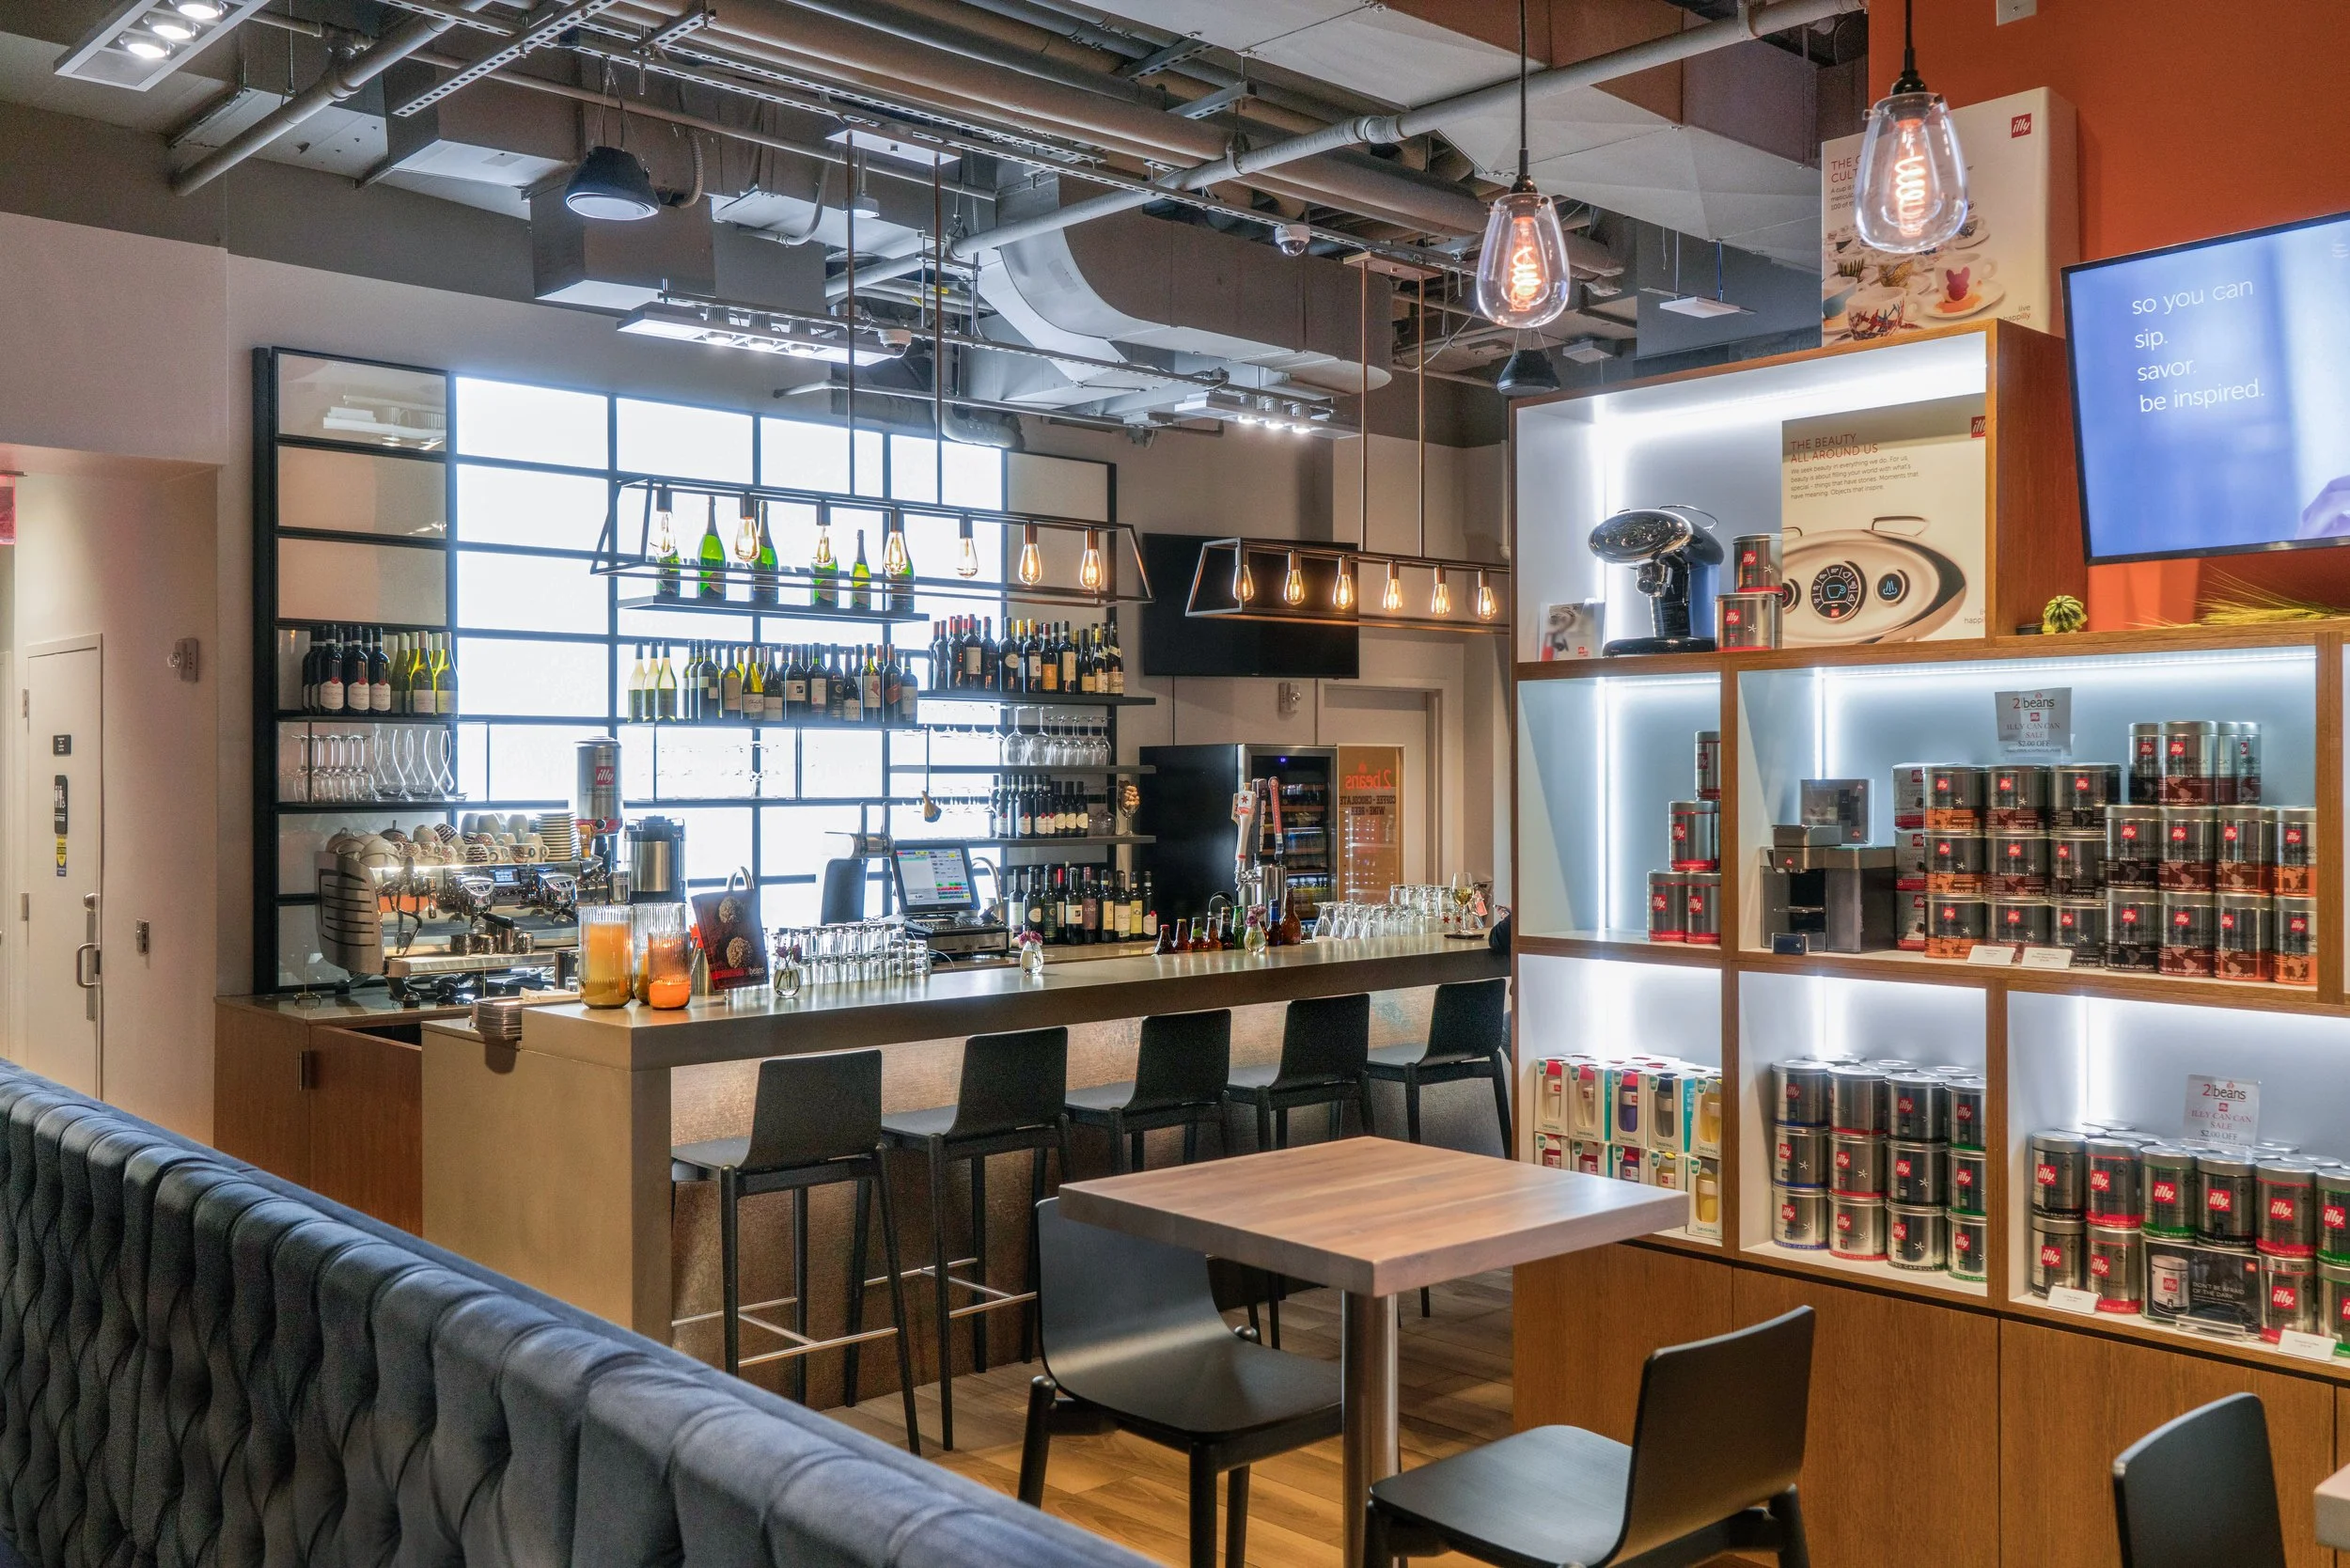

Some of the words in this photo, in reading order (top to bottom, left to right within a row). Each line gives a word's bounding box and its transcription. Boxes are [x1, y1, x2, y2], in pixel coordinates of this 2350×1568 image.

[2013, 118, 2030, 134] illy
[1831, 158, 1852, 171] THE
[1831, 168, 1858, 182] CULT
[2132, 298, 2156, 315] so
[2163, 290, 2204, 315] you
[2212, 280, 2253, 301] can
[2135, 328, 2169, 351] sip.
[2137, 360, 2197, 382] savor.
[2139, 394, 2167, 413] be
[2174, 377, 2264, 409] inspired.
[1791, 438, 1811, 450] THE
[1815, 433, 1856, 448] BEAUTY
[1791, 451, 1810, 463] ALL
[1812, 447, 1860, 461] AROUND
[1863, 443, 1878, 454] US
[1743, 553, 1756, 564] illy
[1726, 612, 1739, 623] illy
[2013, 698, 2021, 709] 2
[2023, 697, 2055, 709] beans
[2170, 744, 2184, 754] illy
[597, 769, 614, 784] illy
[1672, 824, 1684, 839] illy
[2123, 827, 2136, 838] illy
[2172, 829, 2186, 839] illy
[1653, 896, 1666, 910] illy
[1688, 897, 1702, 911] illy
[2123, 911, 2136, 921] illy
[2175, 914, 2188, 924] illy
[2291, 920, 2305, 931] illy
[1787, 1085, 1800, 1098] illy
[2202, 1083, 2211, 1096] 2
[2213, 1084, 2246, 1100] beans
[1899, 1100, 1913, 1113] illy
[1957, 1106, 1971, 1121] illy
[1779, 1146, 1791, 1159] illy
[1837, 1153, 1850, 1168] illy
[1897, 1162, 1910, 1176] illy
[2038, 1168, 2055, 1183] illy
[1958, 1171, 1971, 1185] illy
[2092, 1173, 2108, 1189] illy
[2154, 1185, 2174, 1201] illy
[2209, 1192, 2230, 1209] illy
[1782, 1207, 1795, 1220] illy
[2271, 1201, 2292, 1218] illy
[1838, 1215, 1850, 1230] illy
[2325, 1209, 2344, 1226] illy
[1893, 1225, 1906, 1239] illy
[1956, 1235, 1969, 1250] illy
[2042, 1248, 2060, 1264] illy
[2092, 1258, 2108, 1274] illy
[2192, 1281, 2212, 1290] DON'T
[2222, 1285, 2245, 1294] AFRAID
[2273, 1290, 2294, 1307] illy
